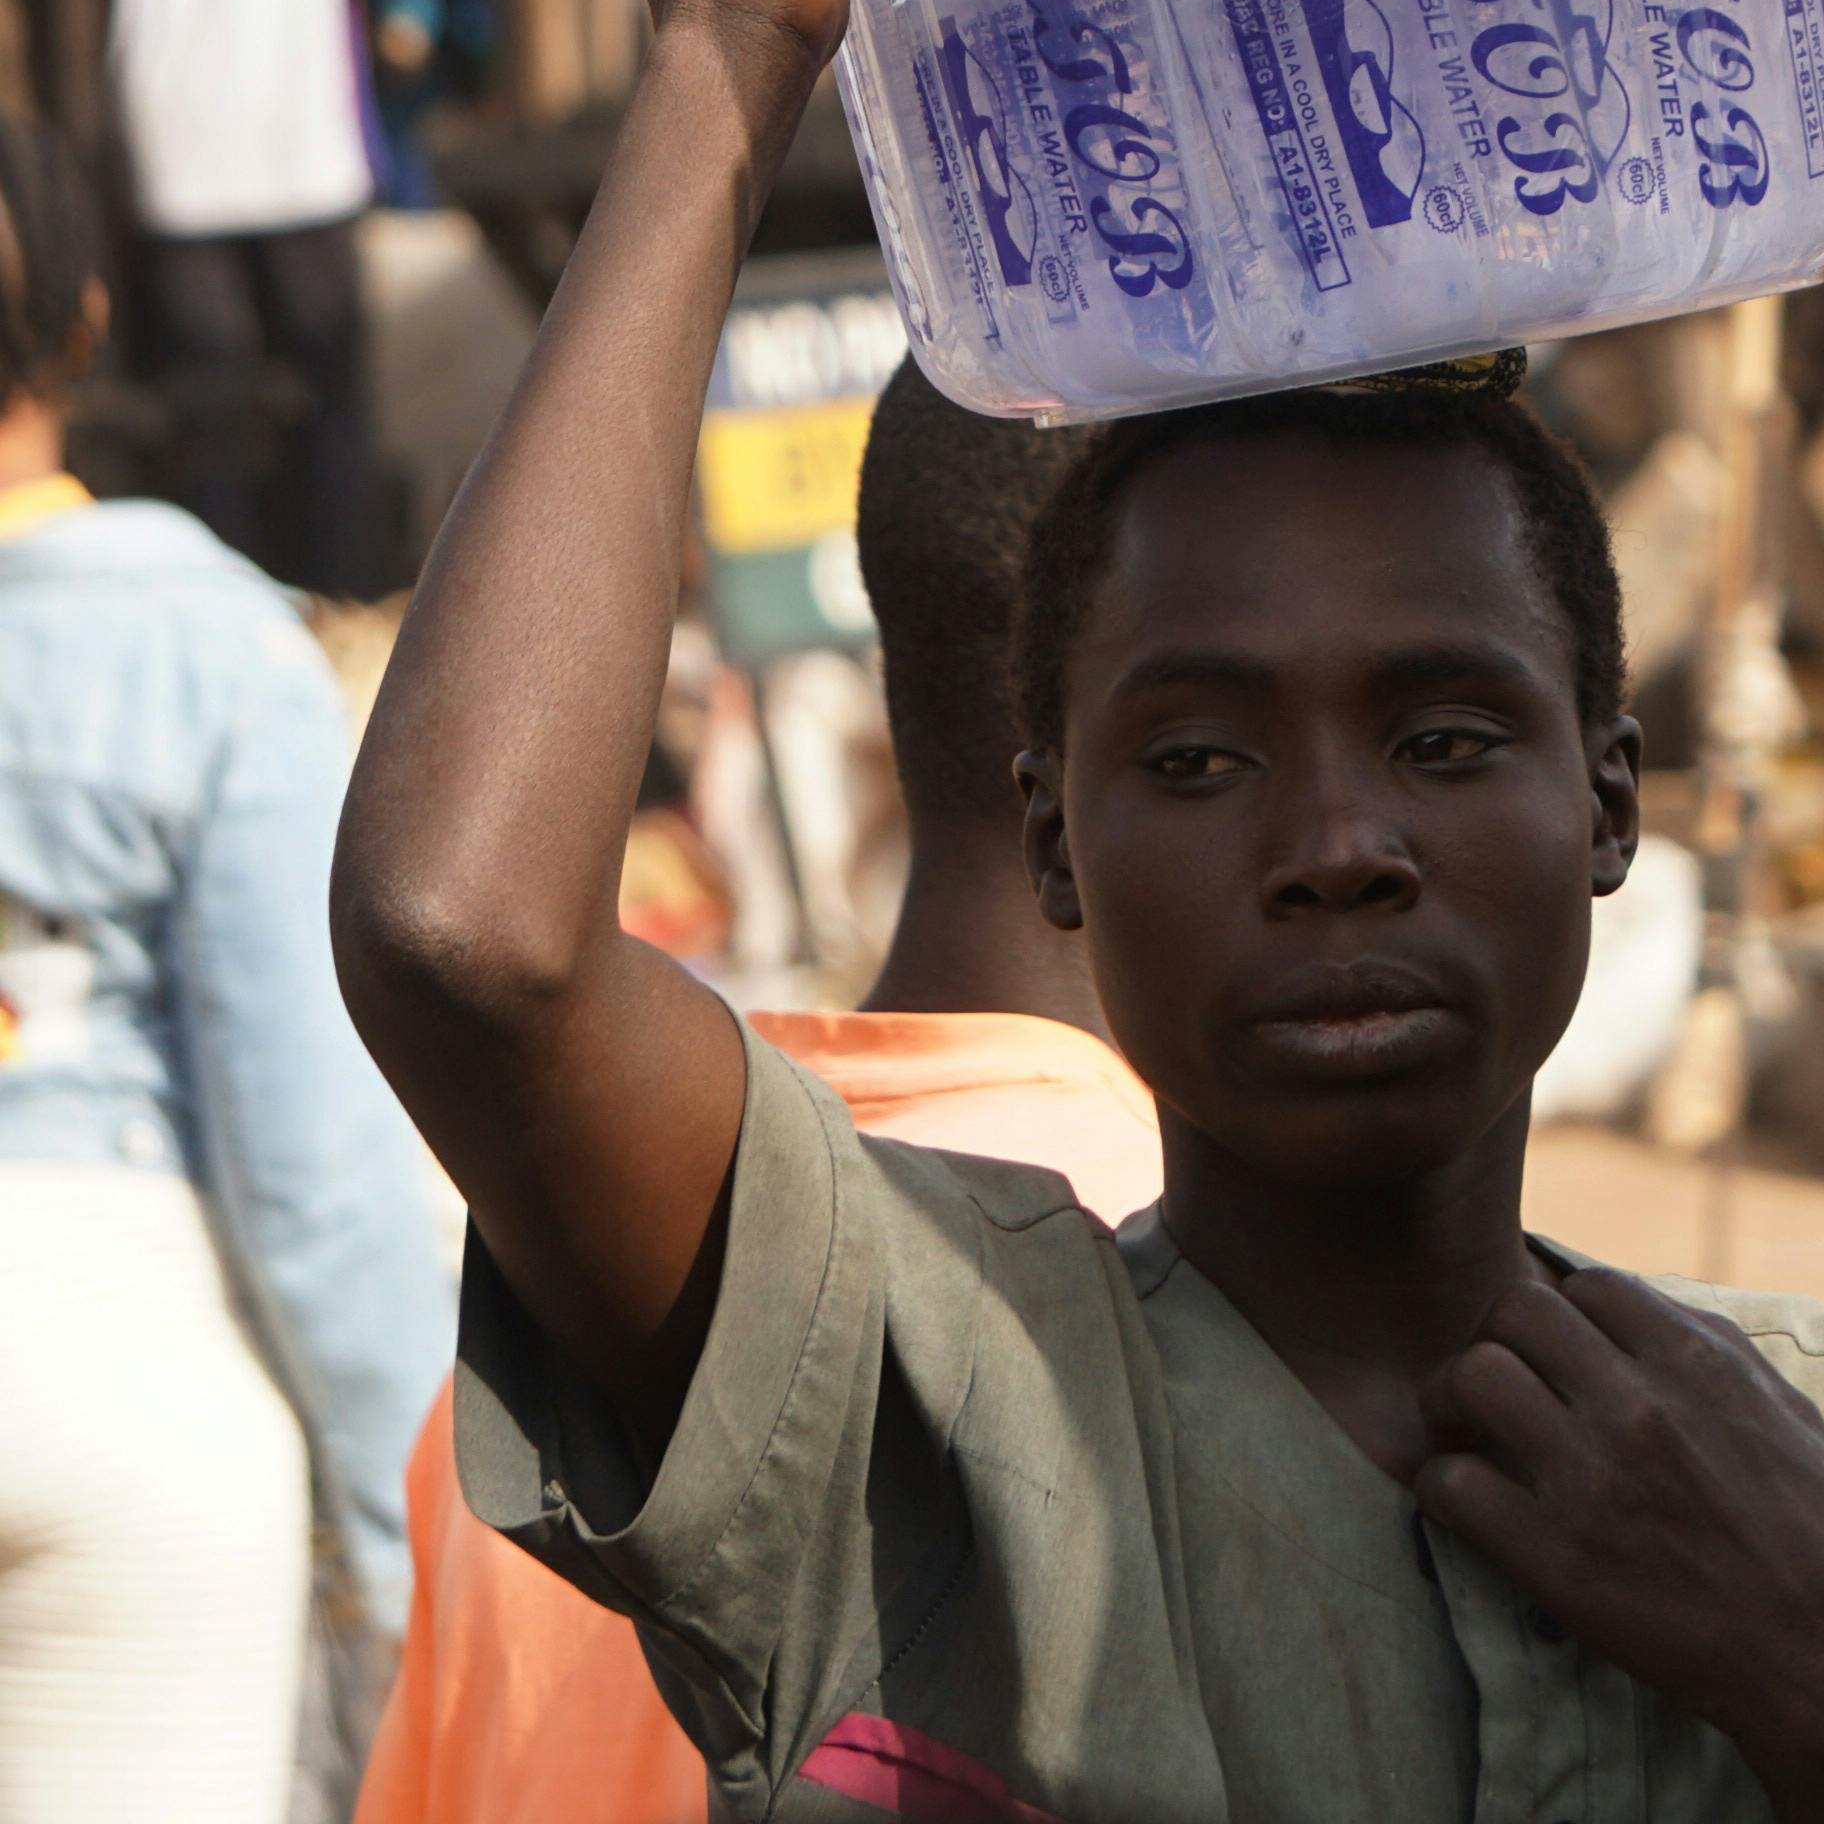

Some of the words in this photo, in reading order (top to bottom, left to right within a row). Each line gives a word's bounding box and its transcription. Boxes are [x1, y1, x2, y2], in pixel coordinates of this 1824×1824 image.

[1246, 40, 1275, 84] REG
[1280, 38, 1298, 59] IN
[1810, 21, 1824, 60] DRY
[1287, 63, 1299, 77] A
[1649, 31, 1685, 138] WATER
[1792, 28, 1819, 150] A1-8312L
[1292, 81, 1318, 133] COOL
[1438, 55, 1492, 161] WATER
[1007, 27, 1051, 125] TABLE
[1036, 128, 1088, 236] WATER
[1310, 135, 1334, 172] DRY
[1651, 136, 1662, 162] NET
[1278, 144, 1332, 264] A1-8312L
[1452, 161, 1467, 186] NET
[1461, 186, 1490, 239] VOLUME
[1628, 162, 1645, 204] 60cl
[1654, 162, 1671, 215] VOLUME
[960, 190, 978, 229] DRY
[1324, 177, 1356, 239] PLACE
[1433, 191, 1457, 230] 60cl
[1058, 233, 1071, 259] NET
[1045, 257, 1065, 299] 60cl
[1064, 257, 1091, 312] VOLUME
